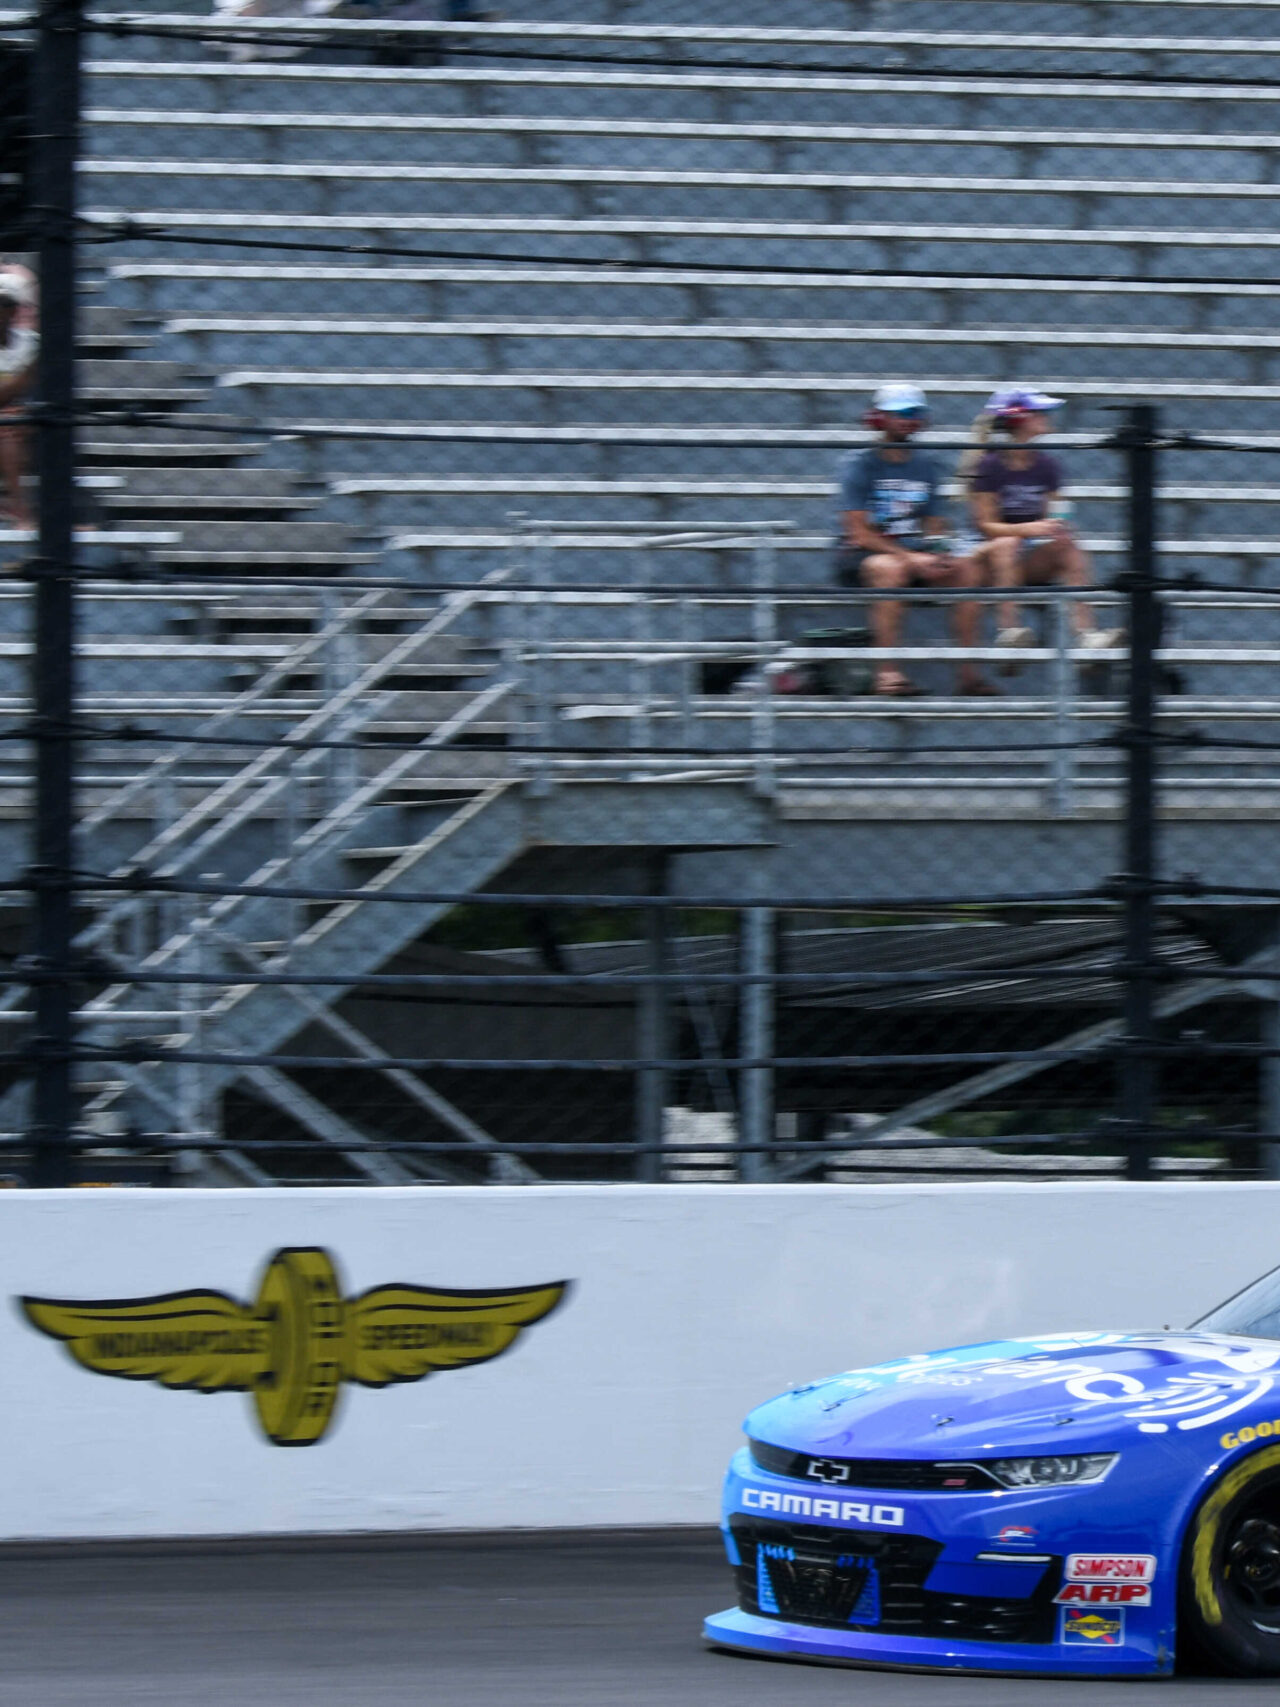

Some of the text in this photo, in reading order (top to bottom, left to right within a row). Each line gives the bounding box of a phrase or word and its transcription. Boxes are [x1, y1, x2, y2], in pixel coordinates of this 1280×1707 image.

[741, 1488, 904, 1526] CAMARO
[1074, 1559, 1147, 1577] SIMPSON
[1058, 1585, 1148, 1602] ARP
